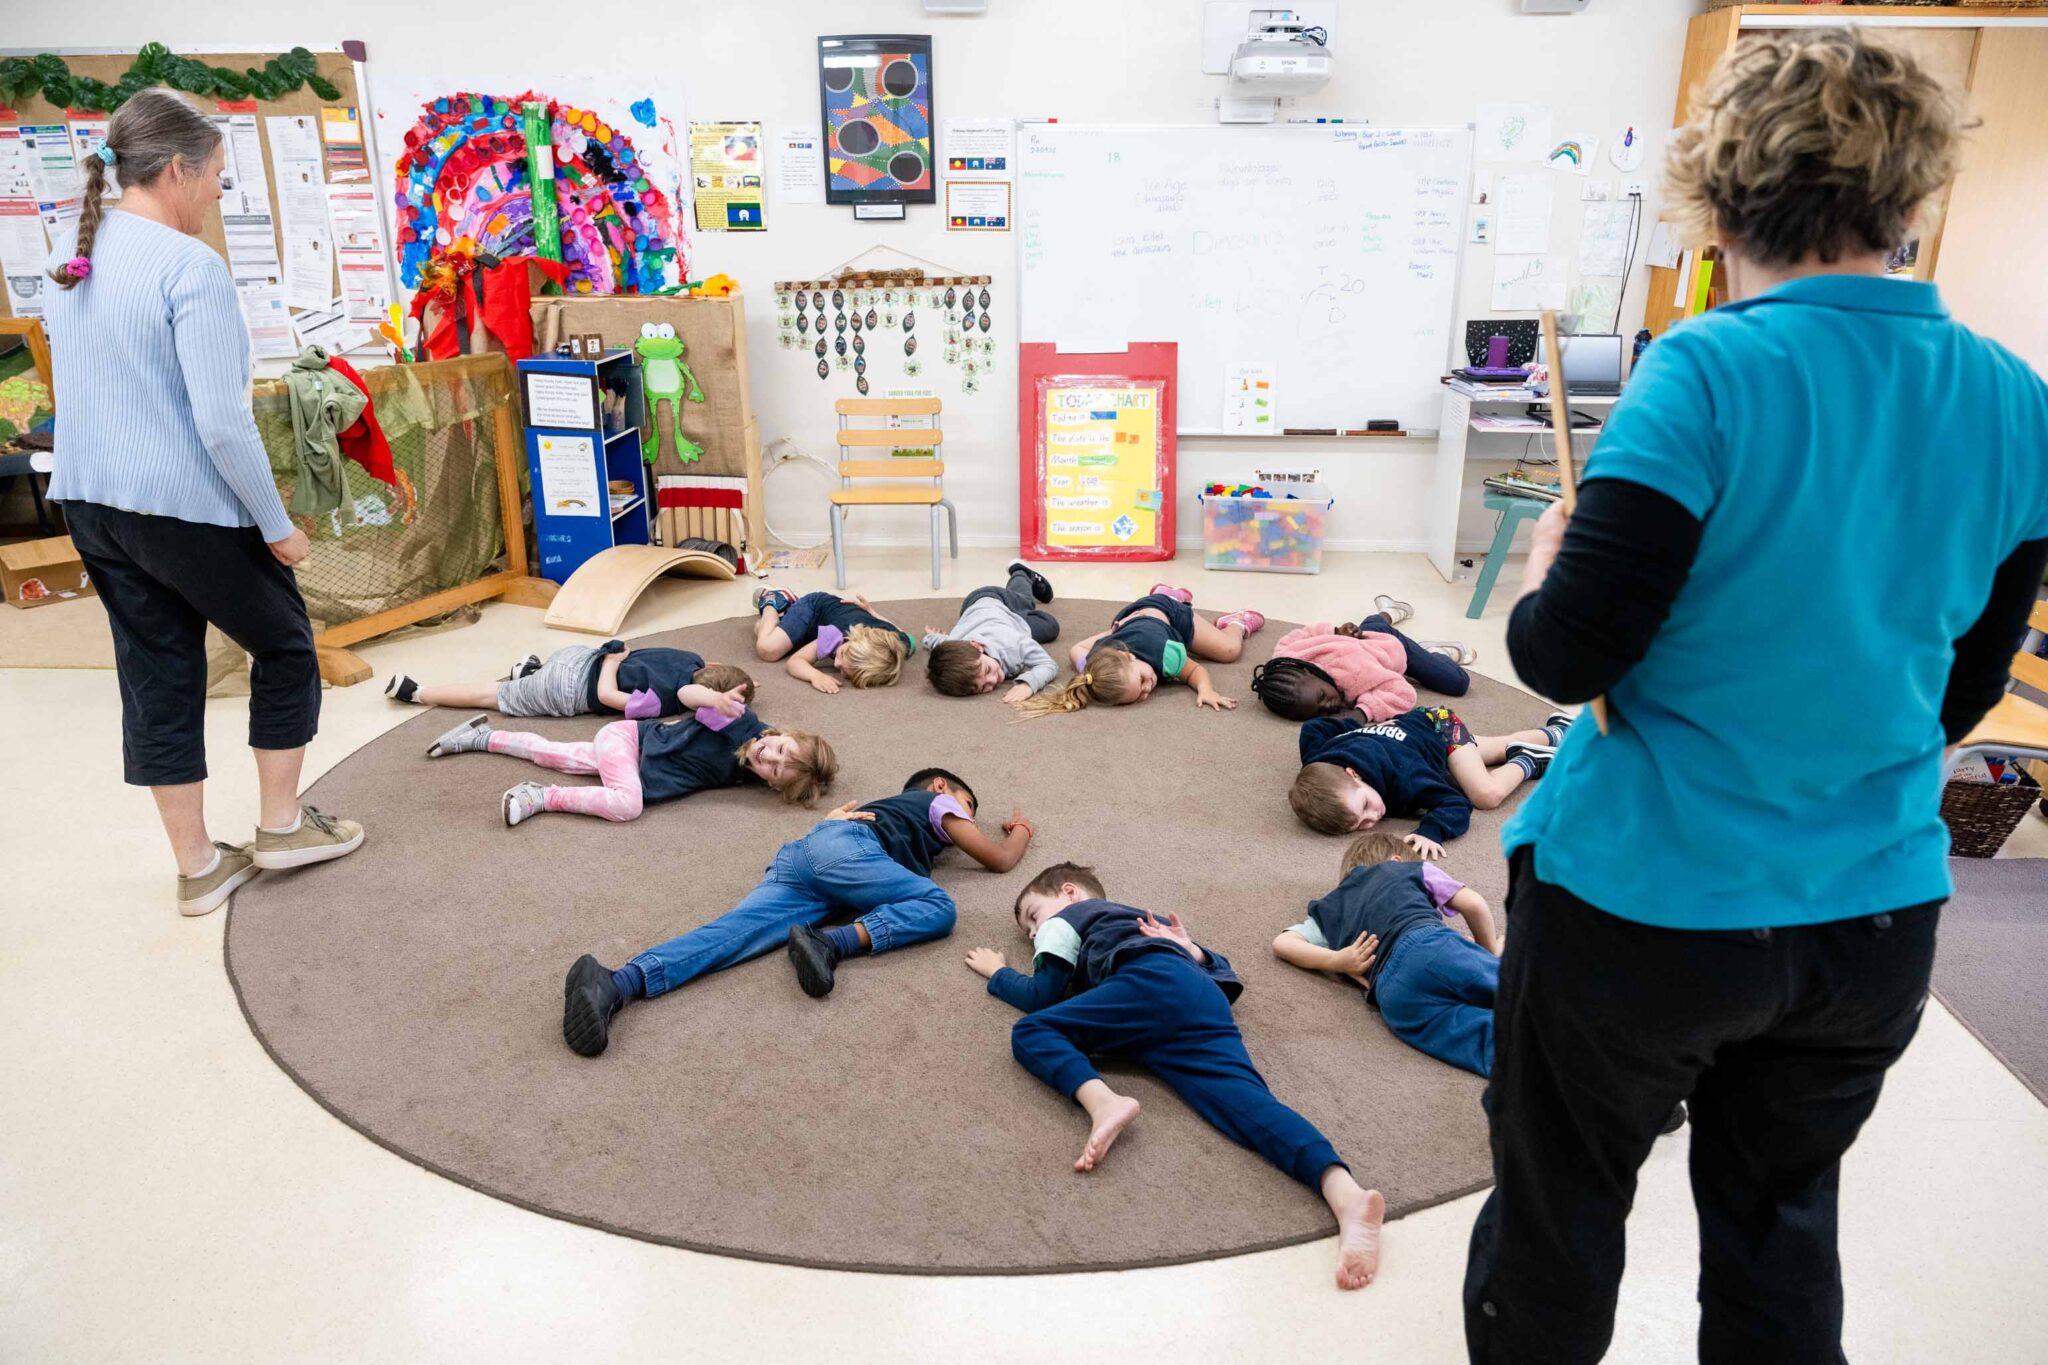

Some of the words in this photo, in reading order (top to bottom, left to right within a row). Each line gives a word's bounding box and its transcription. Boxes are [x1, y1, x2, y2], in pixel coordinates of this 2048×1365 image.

[1339, 274, 1366, 294] 20
[1051, 456, 1077, 465] Month
[1052, 478, 1069, 486] Year
